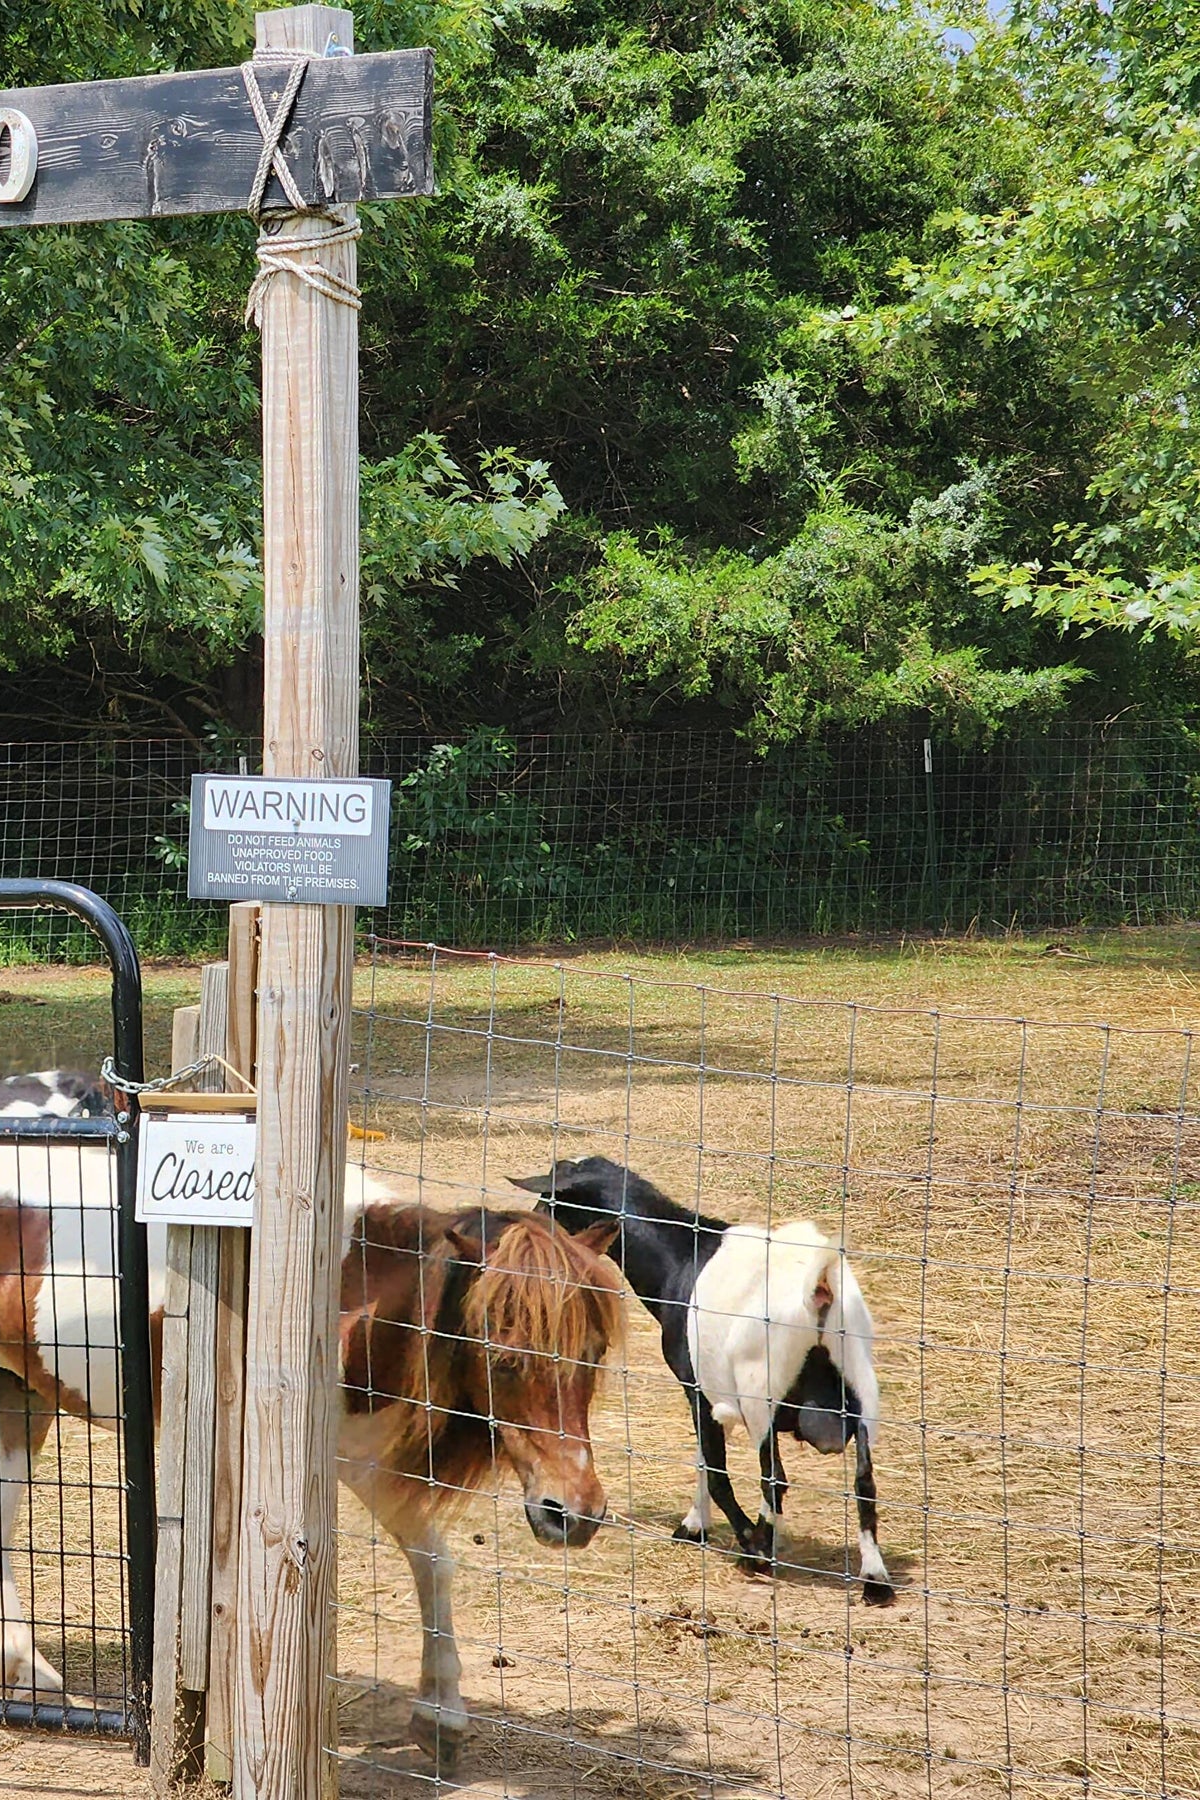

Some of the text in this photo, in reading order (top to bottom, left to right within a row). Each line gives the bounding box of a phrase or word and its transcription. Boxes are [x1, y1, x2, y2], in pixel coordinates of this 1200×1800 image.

[210, 789, 366, 823] WARNING
[228, 834, 340, 848] DO NOT FEED ANIMALS
[232, 847, 336, 861] UNAPPROVED FOOD.
[234, 860, 331, 874] VIOLATORS WILL BE
[207, 872, 359, 889] BANNED FROM THE PREMISES.
[185, 1139, 204, 1154] We
[151, 1151, 255, 1201] Closed
